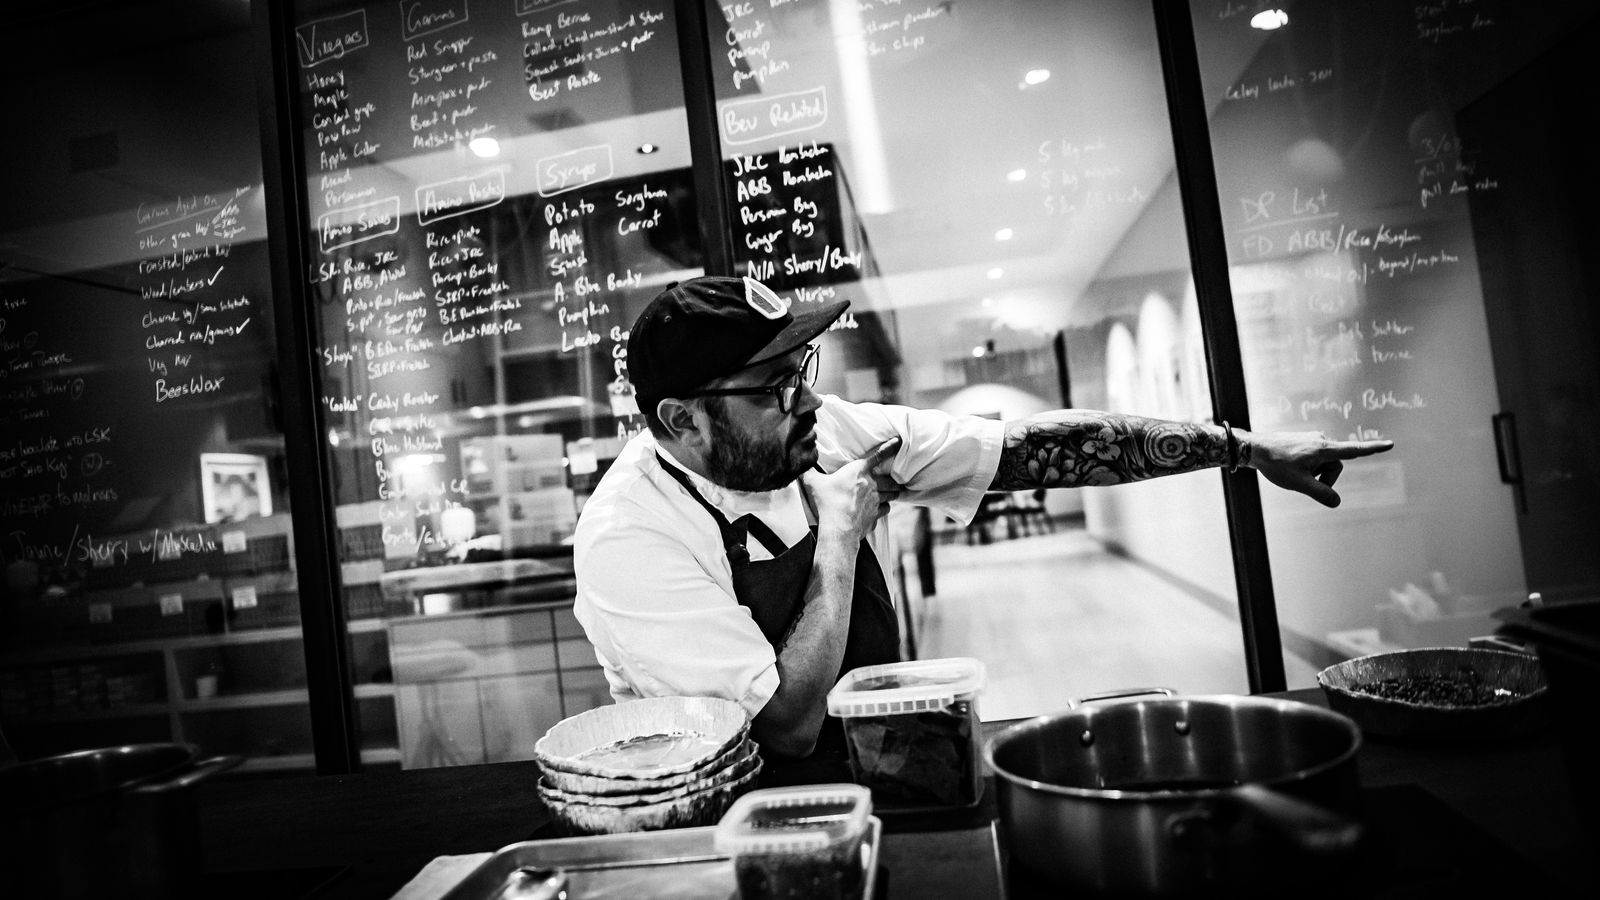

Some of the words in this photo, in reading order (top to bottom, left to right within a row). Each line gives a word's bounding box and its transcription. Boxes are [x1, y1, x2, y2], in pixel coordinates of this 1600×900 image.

[407, 43, 427, 62] Red
[308, 70, 344, 90] Honey
[313, 89, 350, 109] Maple
[725, 110, 757, 136] Bev
[546, 162, 597, 189] Syrups
[730, 152, 769, 177] JRC
[615, 183, 668, 211] Sorghum
[737, 176, 772, 203] ABB
[544, 198, 595, 226] Potato
[618, 209, 661, 236] Carrot
